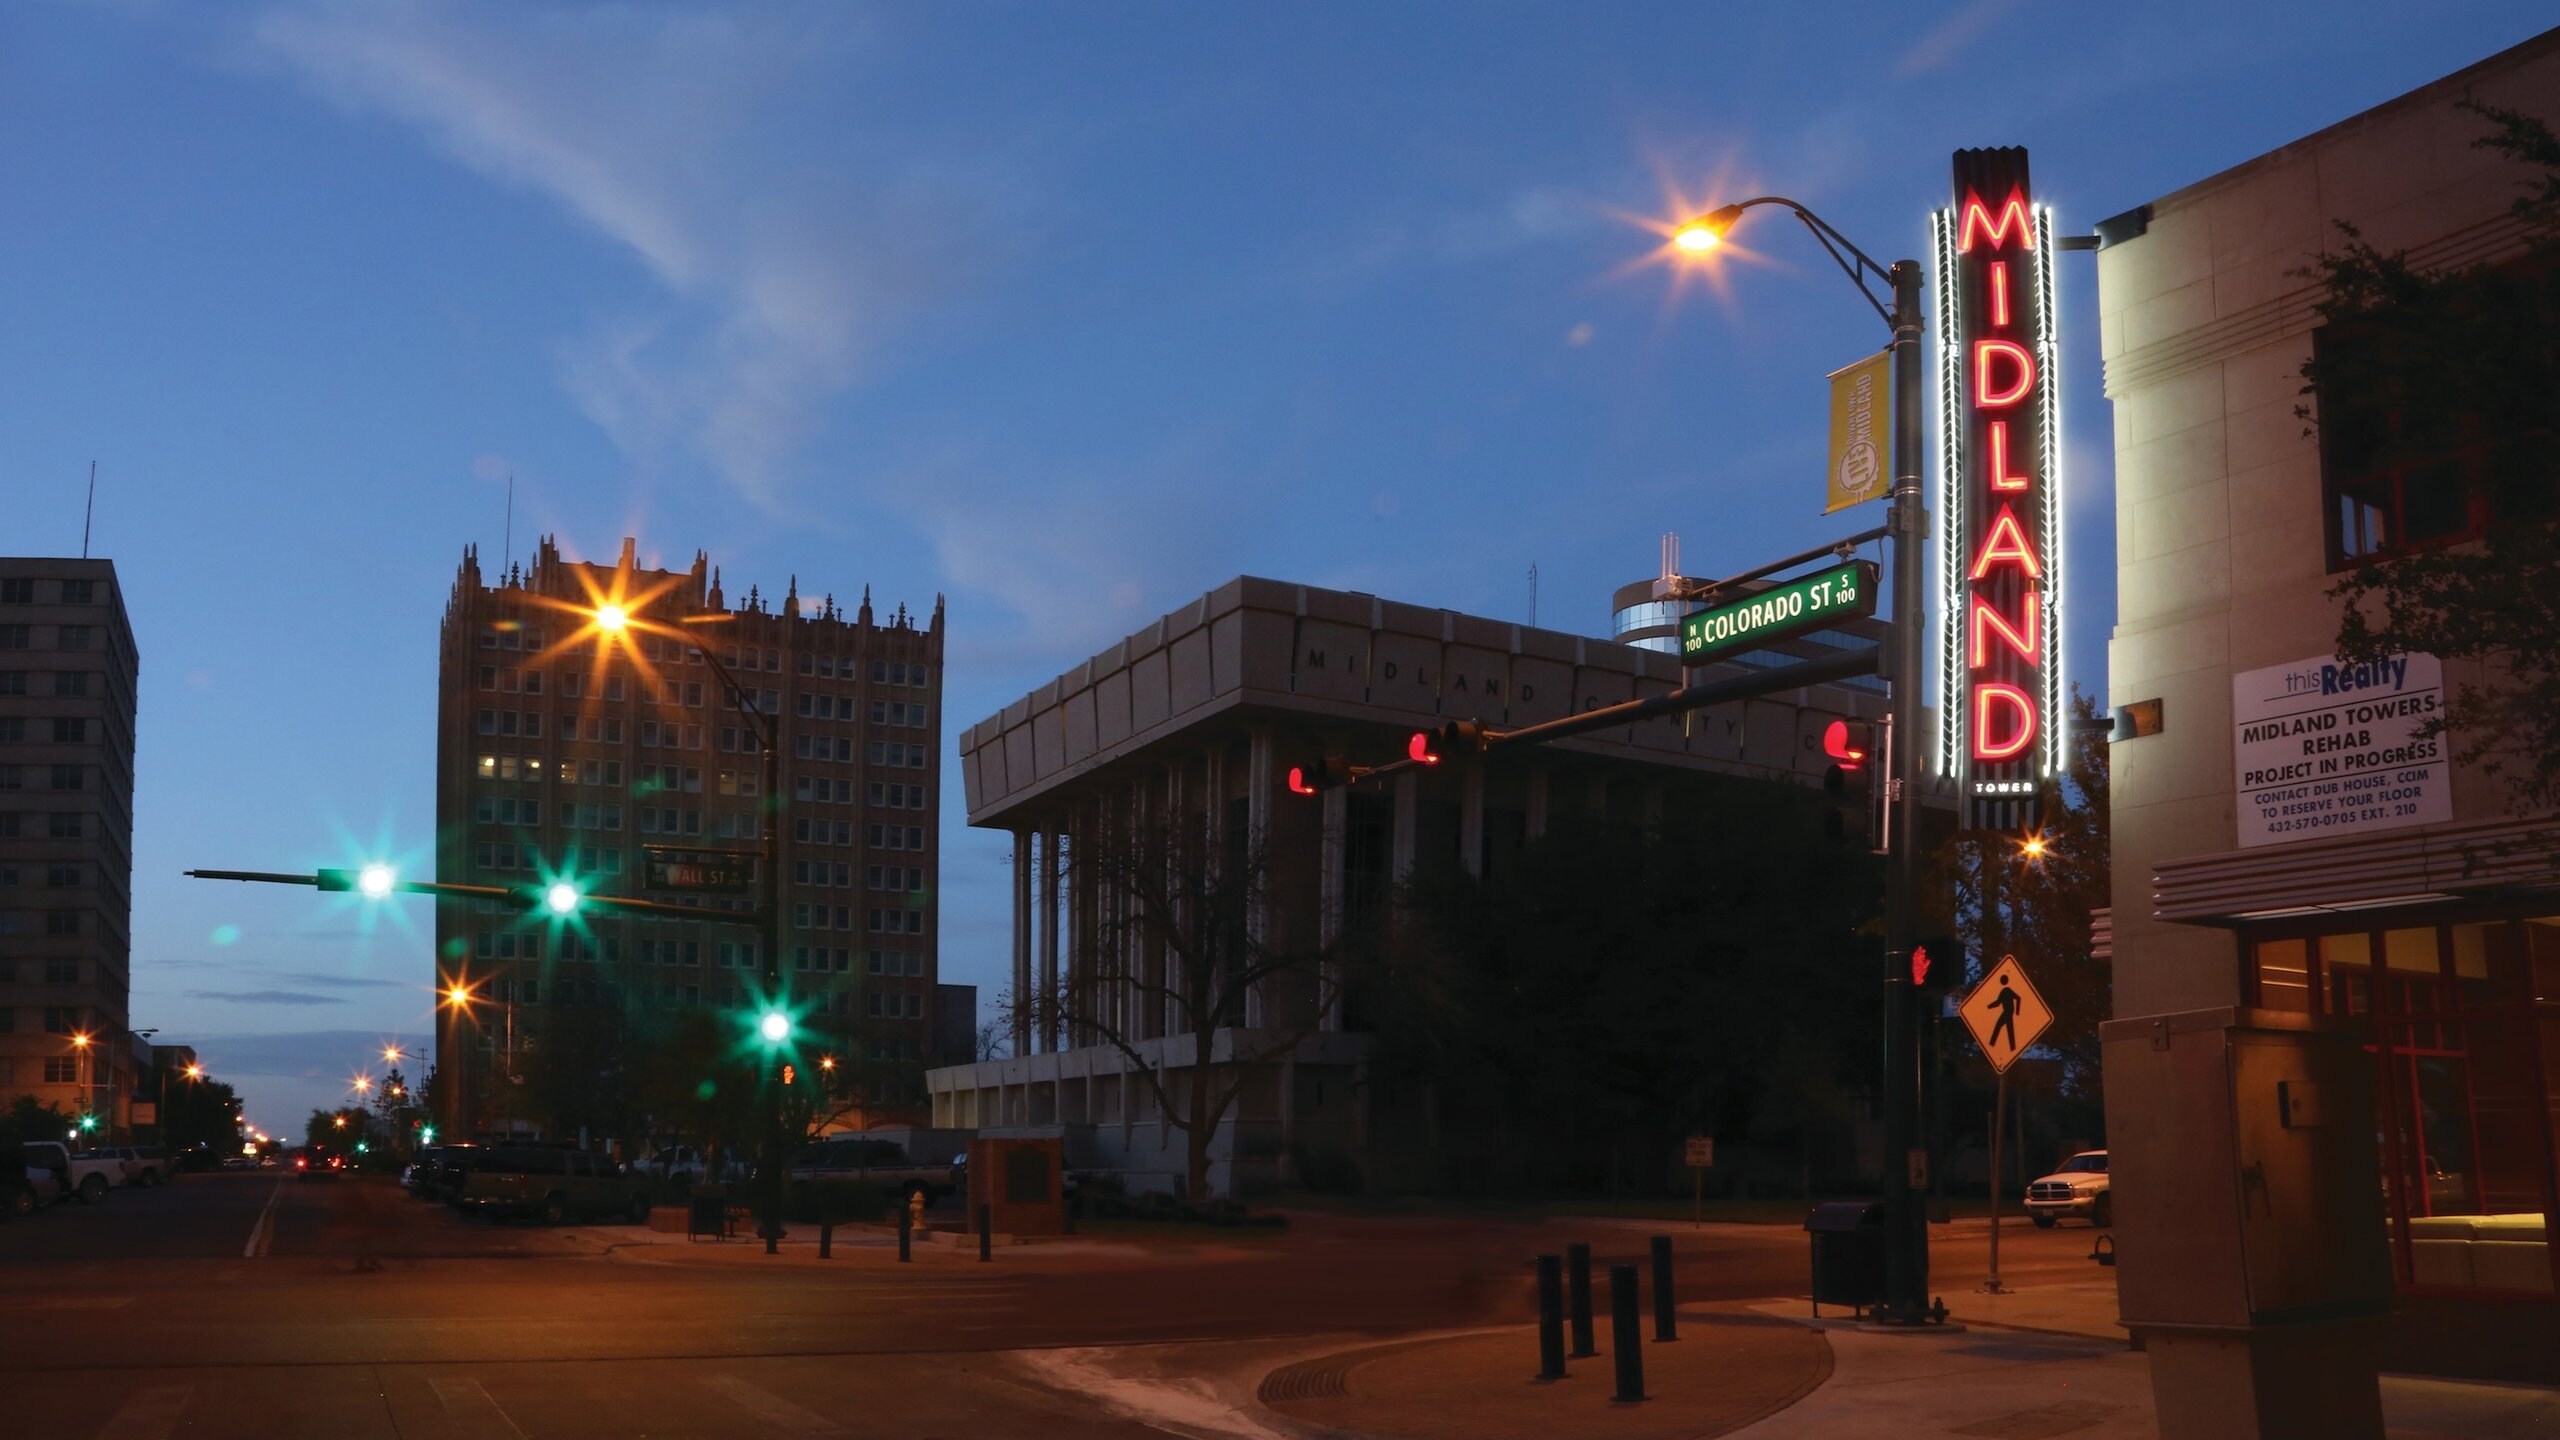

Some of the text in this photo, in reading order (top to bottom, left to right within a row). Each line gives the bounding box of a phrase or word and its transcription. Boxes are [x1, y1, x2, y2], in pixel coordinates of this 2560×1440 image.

[1856, 374, 1872, 441] MIDLAND
[1957, 182, 2041, 759] MIDLAND
[1836, 587, 1856, 605] 100
[1841, 574, 1849, 588] S
[1704, 581, 1832, 643] COLORADO ST
[1685, 636, 1702, 653] 100
[1689, 623, 1697, 637] N
[1309, 648, 1736, 736] MIDLAND CNTY
[2243, 713, 2337, 744] MIDLAND
[2303, 730, 2371, 756] REHAB
[2245, 742, 2438, 786] PROJECT IN PROGRESS
[1975, 782, 2033, 793] TOWER
[2255, 769, 2429, 805] CONTACT DUB HOUSE, CCIM
[2262, 786, 2422, 819] TO RESERVE YOUR FLOOR
[2267, 803, 2417, 834] 432-570-0705 EXT. 210
